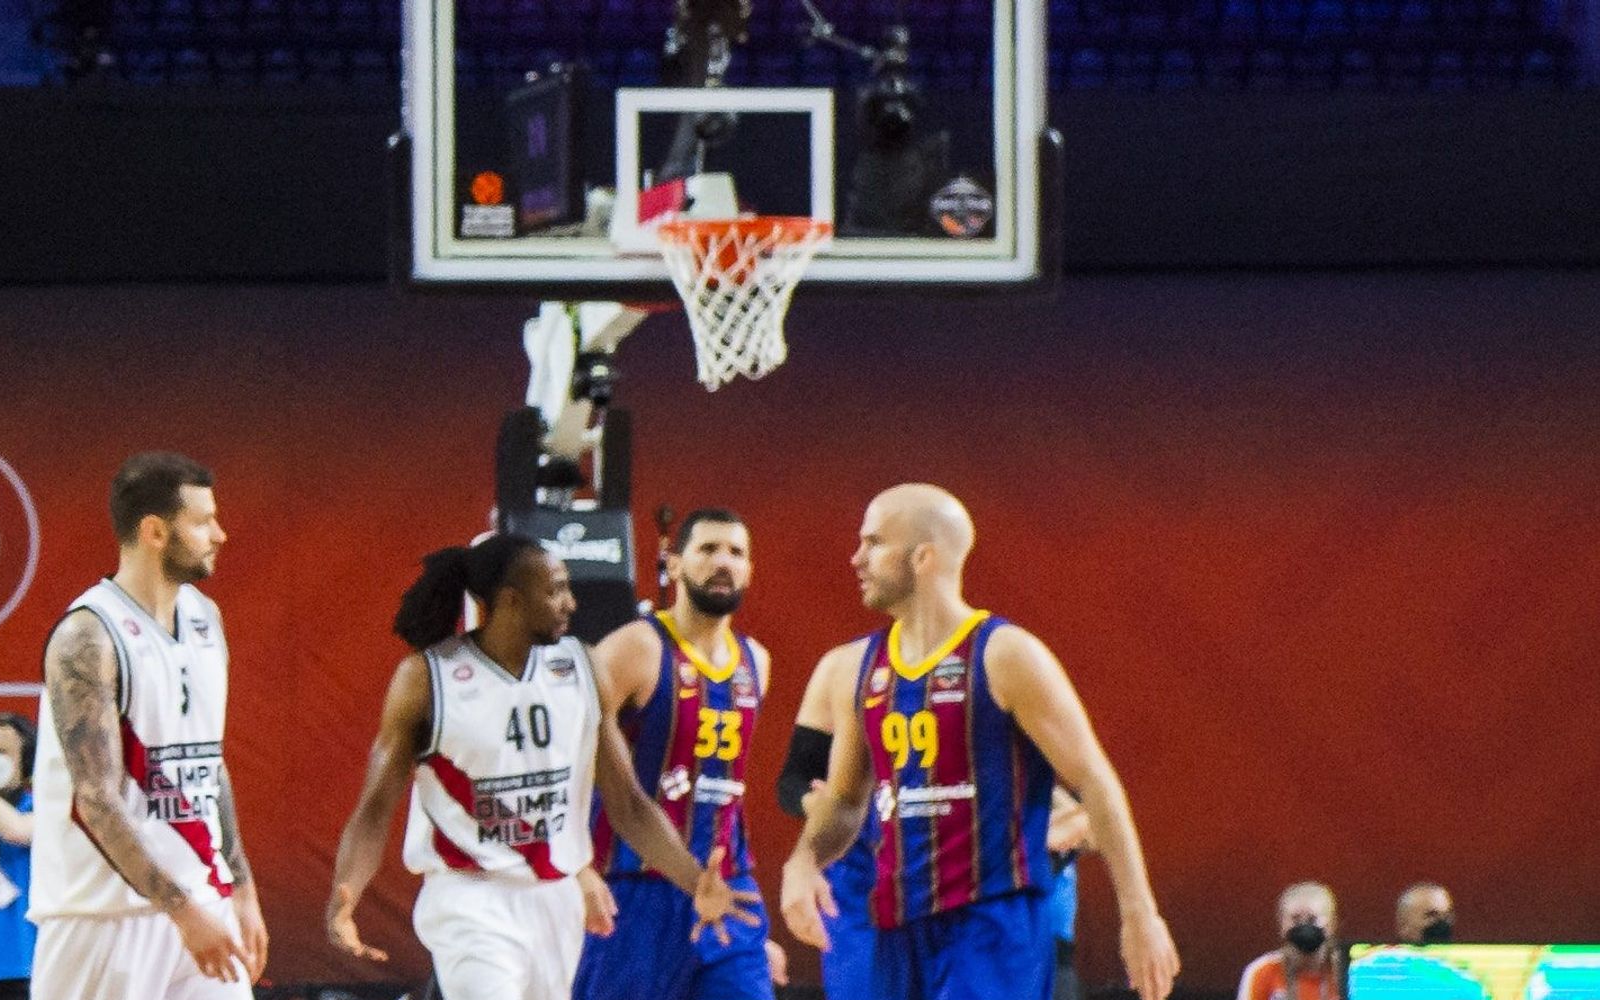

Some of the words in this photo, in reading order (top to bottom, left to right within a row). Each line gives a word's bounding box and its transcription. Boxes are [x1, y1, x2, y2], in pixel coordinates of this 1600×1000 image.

[505, 704, 551, 752] 40
[693, 706, 743, 762] 33
[880, 709, 939, 771] 99
